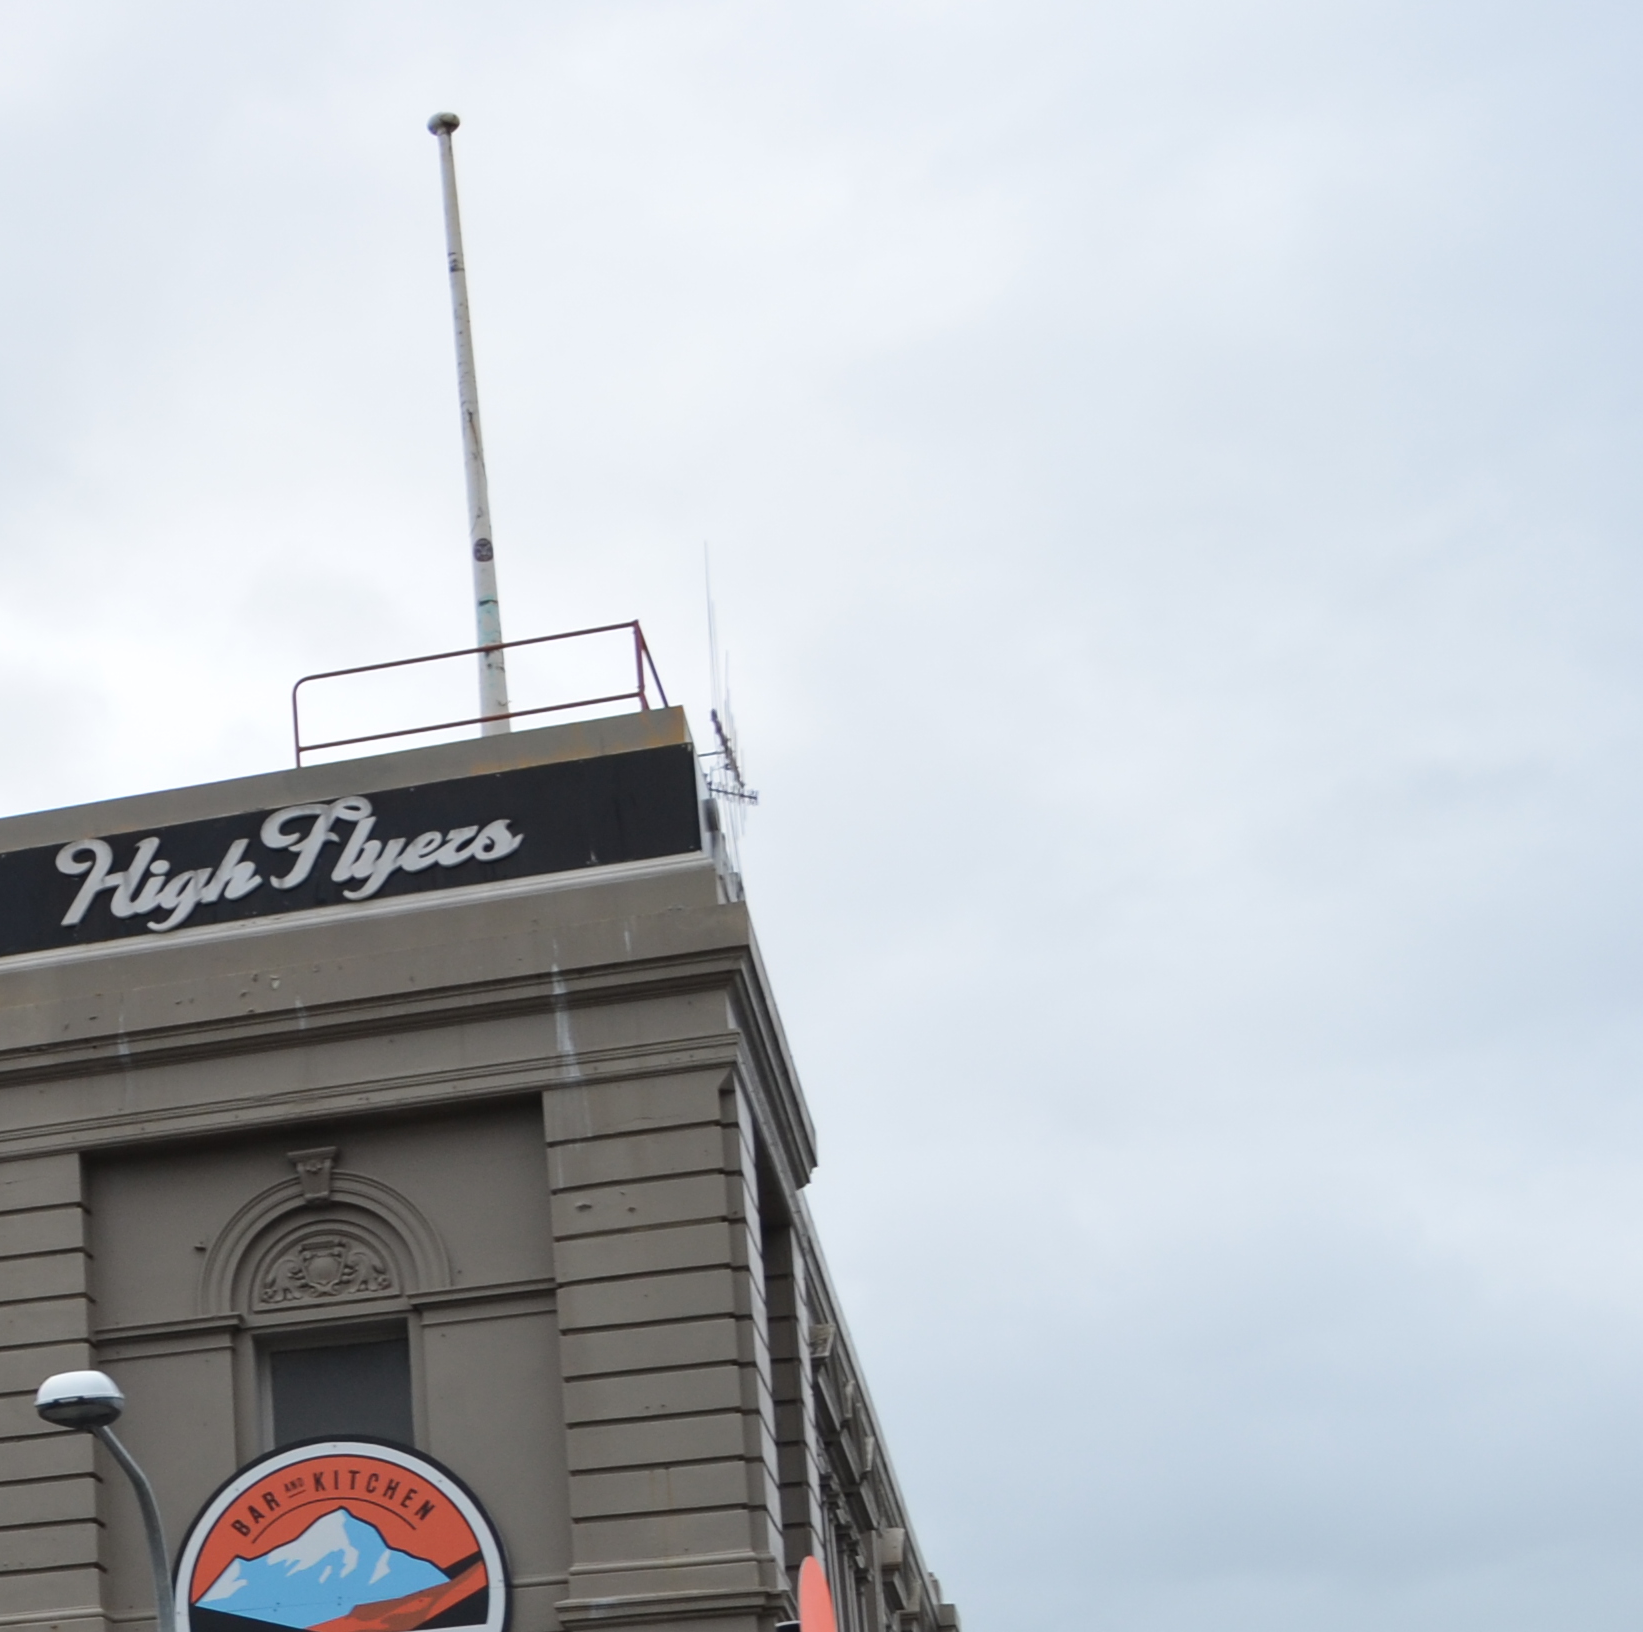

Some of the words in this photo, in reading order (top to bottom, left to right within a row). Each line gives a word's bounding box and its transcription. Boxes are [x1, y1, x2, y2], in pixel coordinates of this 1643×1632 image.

[55, 837, 263, 932] High
[260, 795, 524, 900] Flyers
[230, 1490, 281, 1537] BAR
[284, 1477, 306, 1493] AND
[313, 1469, 437, 1522] KITCHEN
